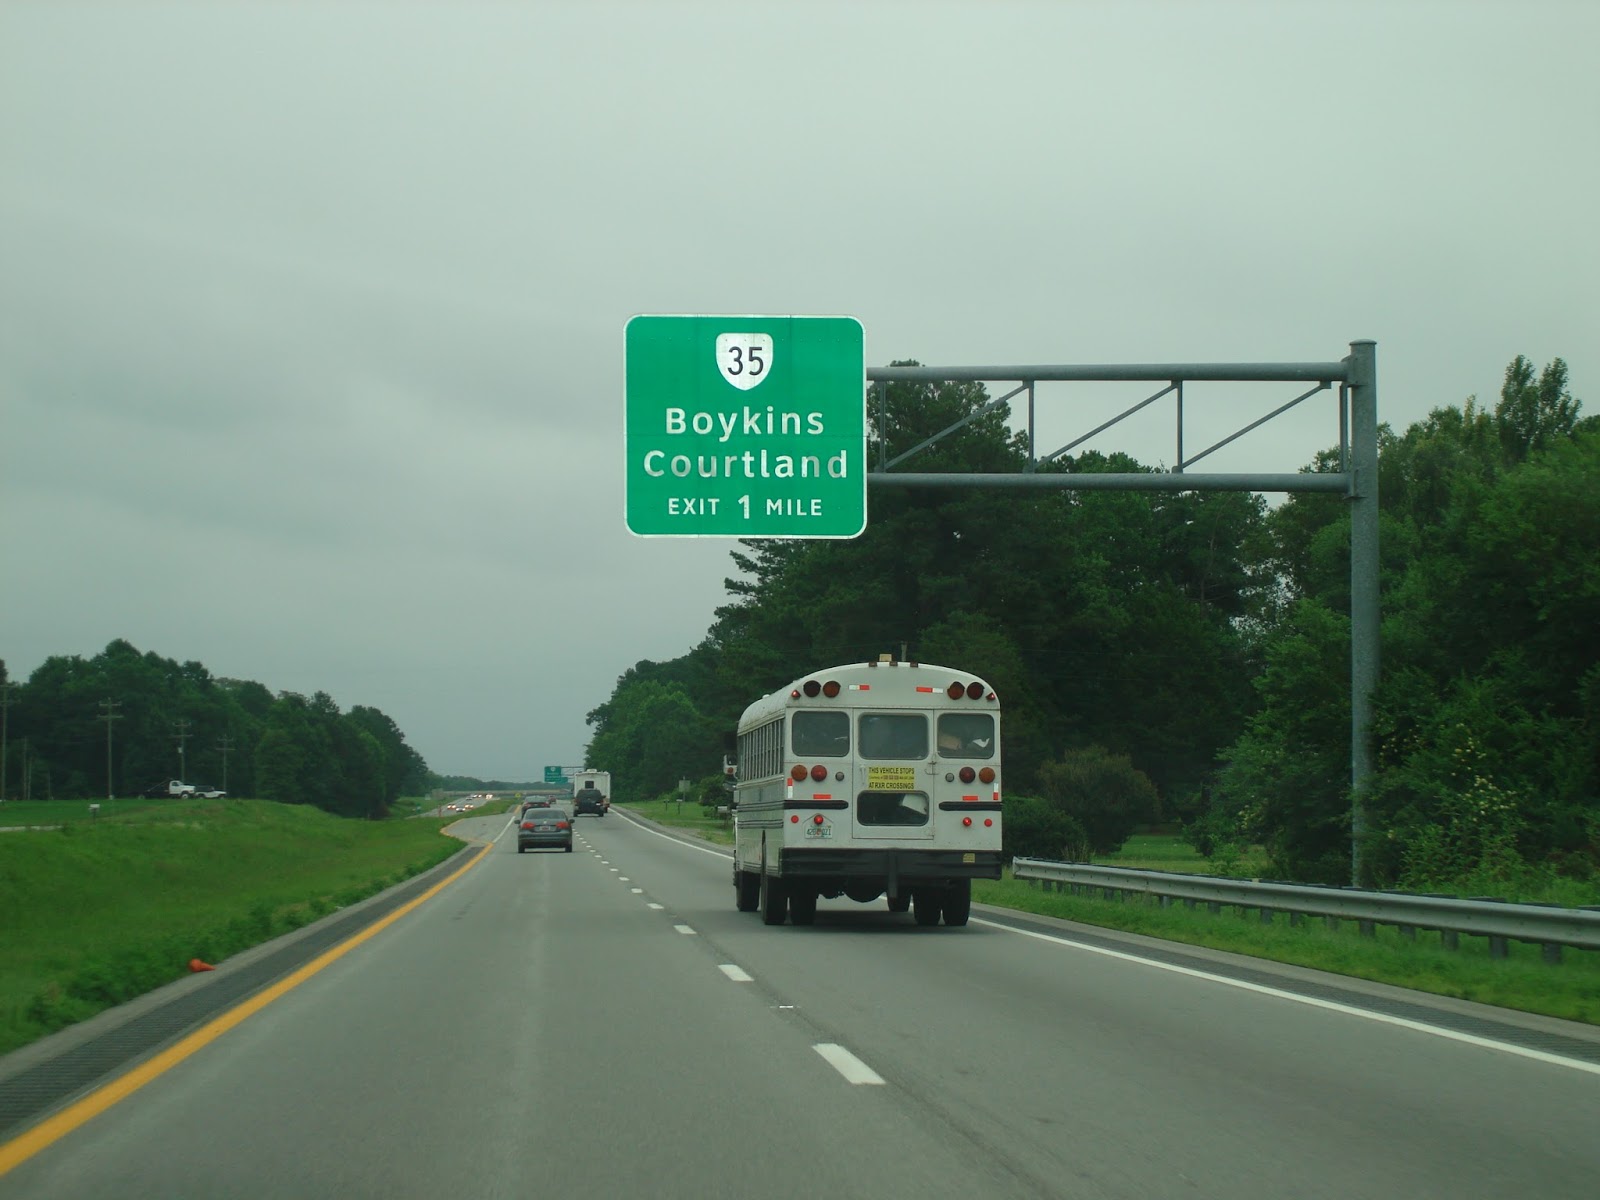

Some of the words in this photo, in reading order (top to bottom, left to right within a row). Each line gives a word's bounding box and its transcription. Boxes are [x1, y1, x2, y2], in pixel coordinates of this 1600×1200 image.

[727, 346, 764, 376] 35
[665, 406, 824, 442] Boykins
[643, 449, 847, 478] Courtland
[668, 498, 720, 515] EXIT
[738, 495, 750, 519] 1
[766, 499, 822, 516] MILE
[886, 782, 914, 790] CROSSINGS
